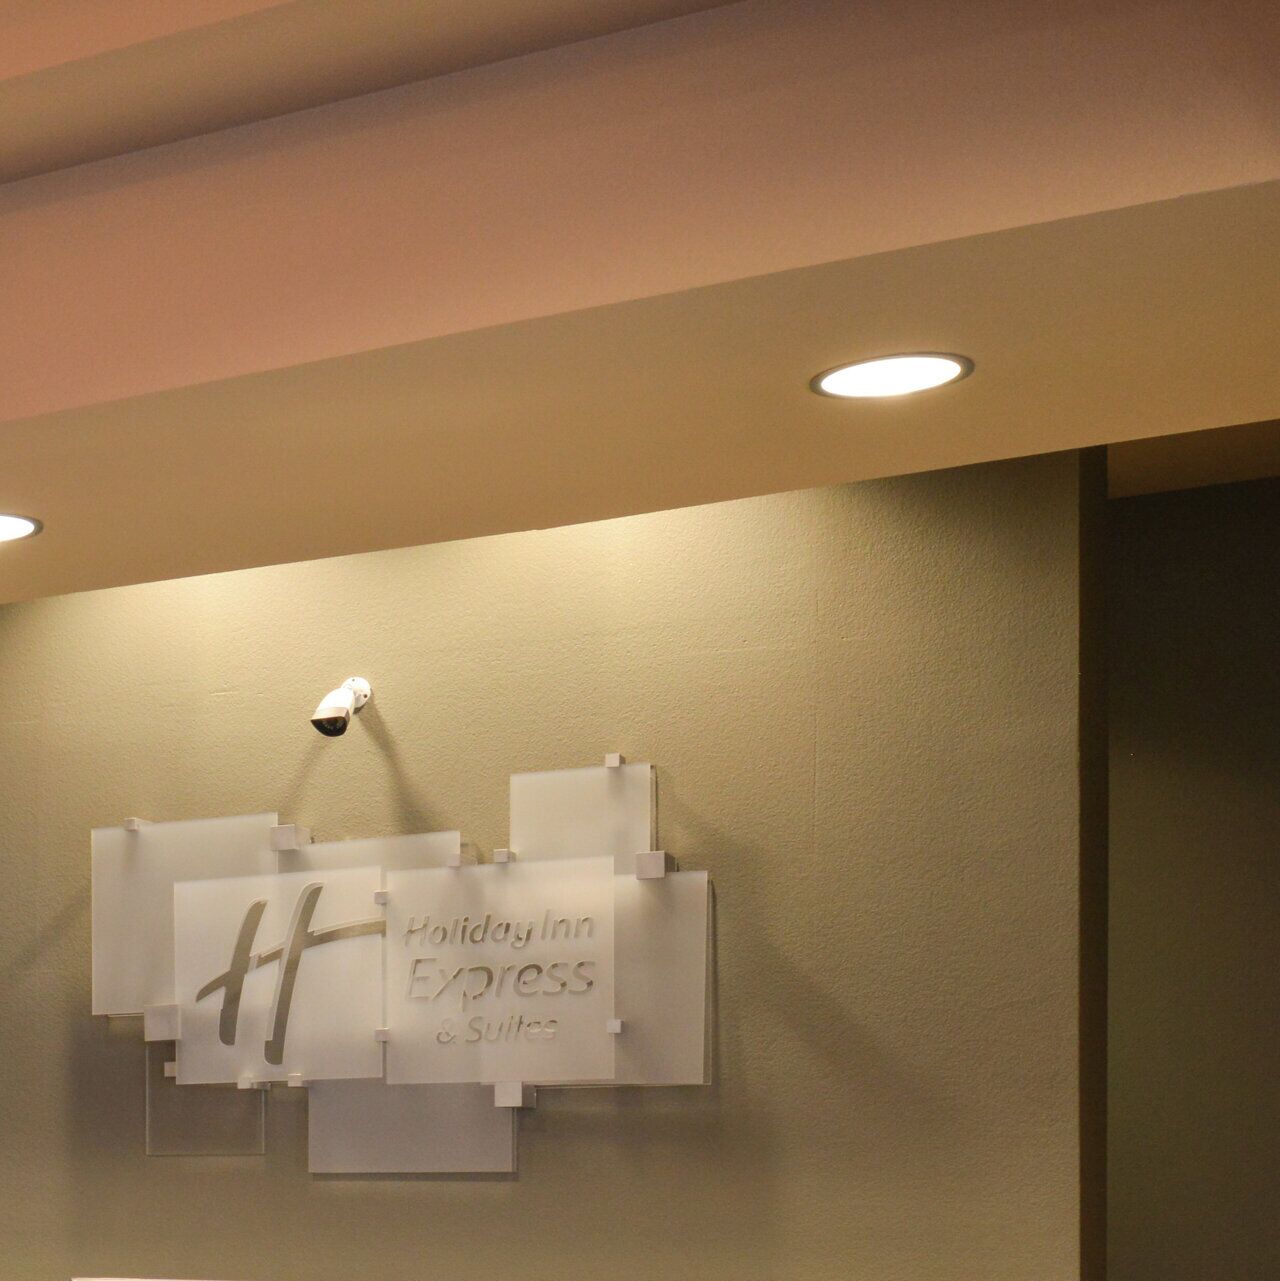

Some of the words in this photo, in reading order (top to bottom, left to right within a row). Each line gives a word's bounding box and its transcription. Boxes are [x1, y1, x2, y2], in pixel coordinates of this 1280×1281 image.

[401, 910, 534, 948] Holiday
[540, 908, 596, 940] Inn
[405, 956, 597, 1011] Express
[435, 1017, 457, 1045] &
[464, 1013, 559, 1044] Suites
